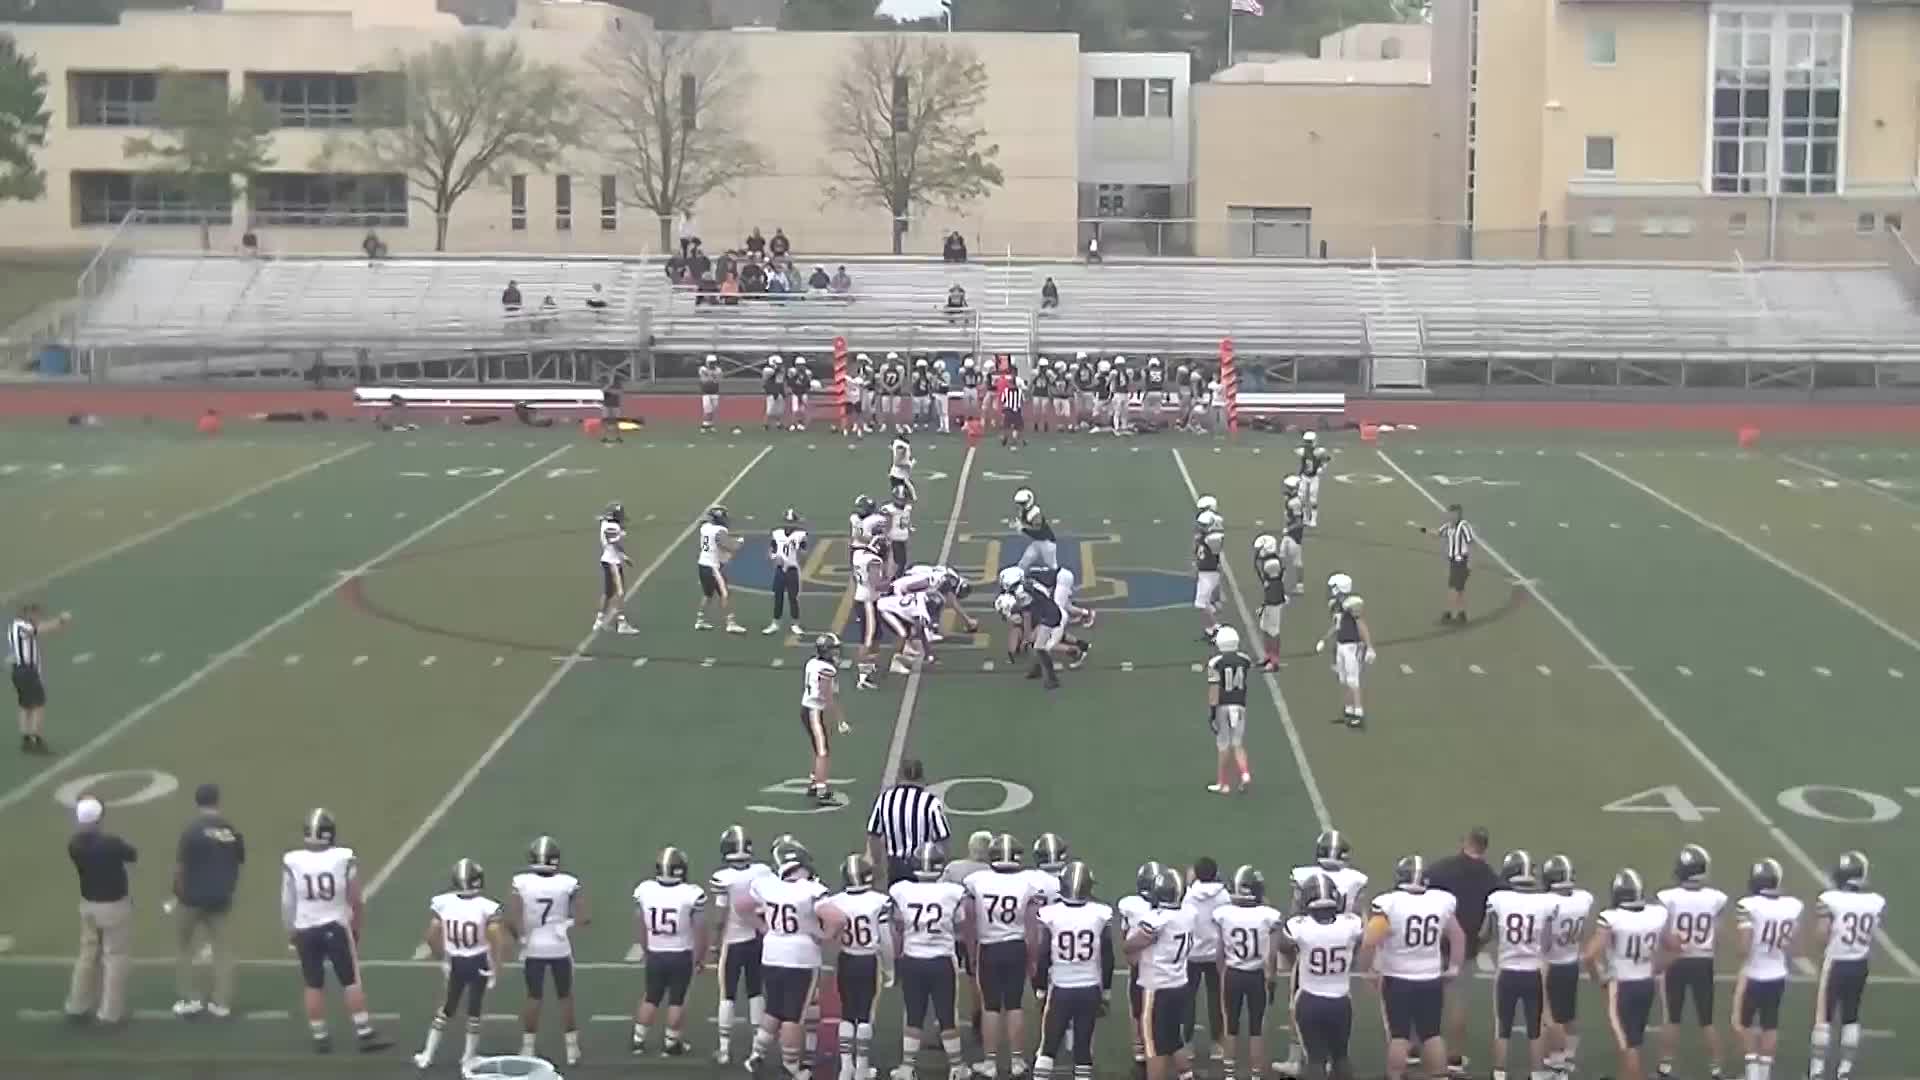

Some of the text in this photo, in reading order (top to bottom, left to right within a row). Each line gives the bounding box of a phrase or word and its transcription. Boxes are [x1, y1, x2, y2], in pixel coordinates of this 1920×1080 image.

[1224, 666, 1244, 691] 14
[304, 872, 335, 901] 19
[536, 898, 553, 926] 7
[648, 907, 678, 936] 15
[766, 901, 799, 934] 76
[907, 903, 943, 934] 72
[982, 894, 1018, 924] 78
[446, 919, 478, 949] 40
[1406, 914, 1440, 947] 66
[1506, 913, 1536, 945] 81
[1677, 911, 1712, 944] 99
[1762, 919, 1793, 952] 48
[1841, 911, 1874, 945] 39
[1058, 929, 1095, 961] 93
[1230, 927, 1262, 960] 31
[1310, 946, 1347, 976] 95
